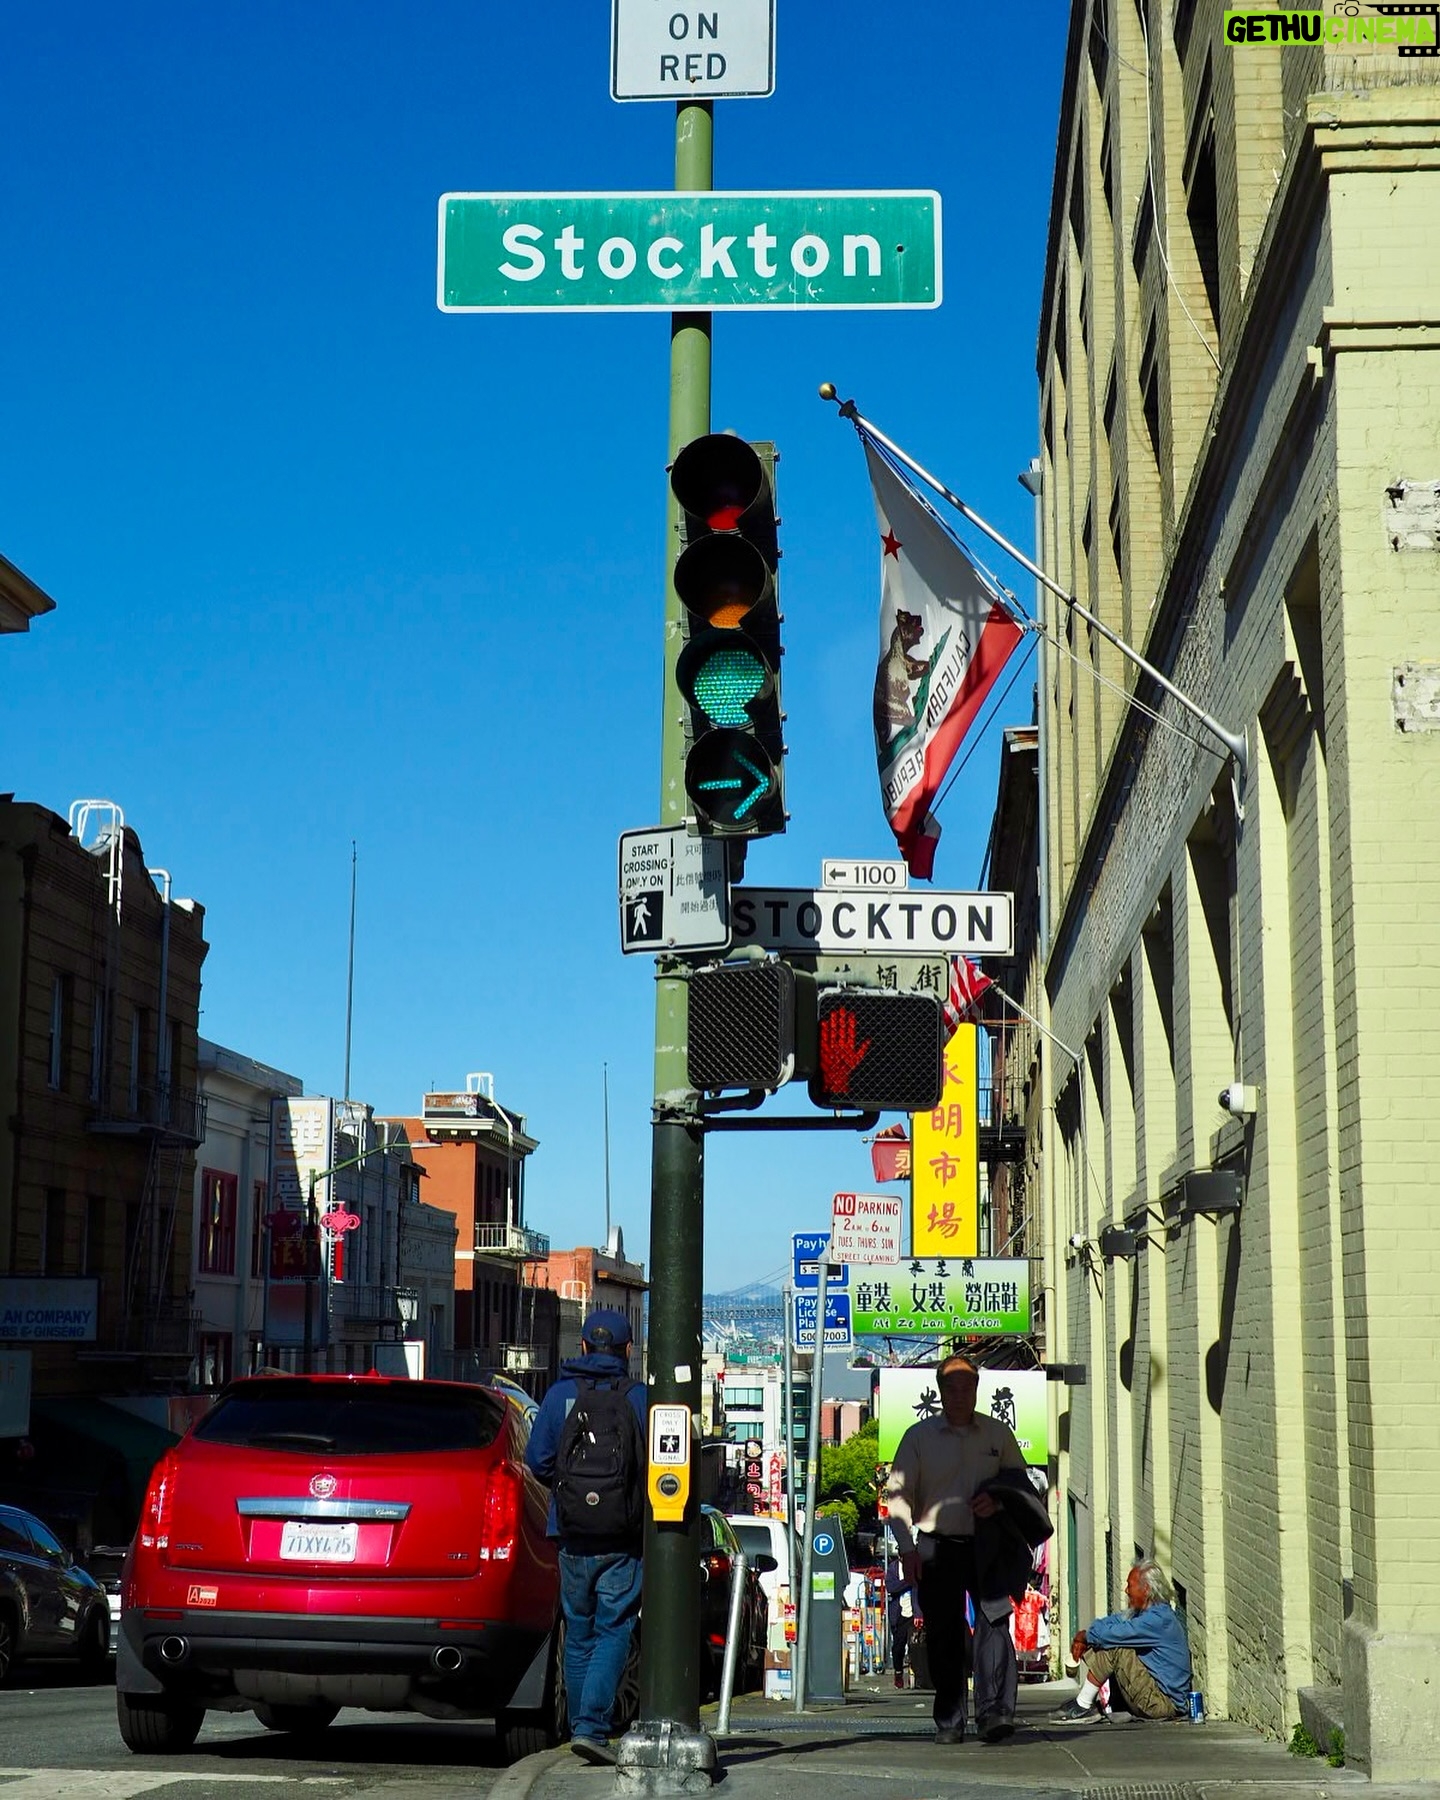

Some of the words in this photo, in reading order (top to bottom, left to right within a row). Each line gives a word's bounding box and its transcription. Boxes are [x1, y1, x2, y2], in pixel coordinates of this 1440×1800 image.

[669, 13, 718, 39] ON
[660, 53, 726, 81] RED
[498, 222, 882, 281] Stockton
[632, 843, 660, 857] START
[623, 858, 668, 874] CROSSING
[649, 874, 664, 887] ON
[853, 866, 897, 885] 1100
[733, 899, 993, 943] STOCKTON
[836, 1195, 854, 1214] NO
[857, 1201, 899, 1216] PARKING
[796, 1239, 814, 1251] Pay
[837, 1252, 860, 1261] STREET
[863, 1254, 895, 1263] CLEANING
[798, 1298, 816, 1310] Pay
[26, 1310, 91, 1324] COMPANY
[799, 1308, 838, 1318] Licese
[799, 1319, 817, 1328] Pla
[922, 1319, 945, 1328] Lan
[952, 1317, 1001, 1328] Fashion
[0, 1325, 17, 1337] BS
[34, 1325, 85, 1338] GINSENG
[801, 1332, 847, 1341] 5007003
[819, 1538, 828, 1551] P
